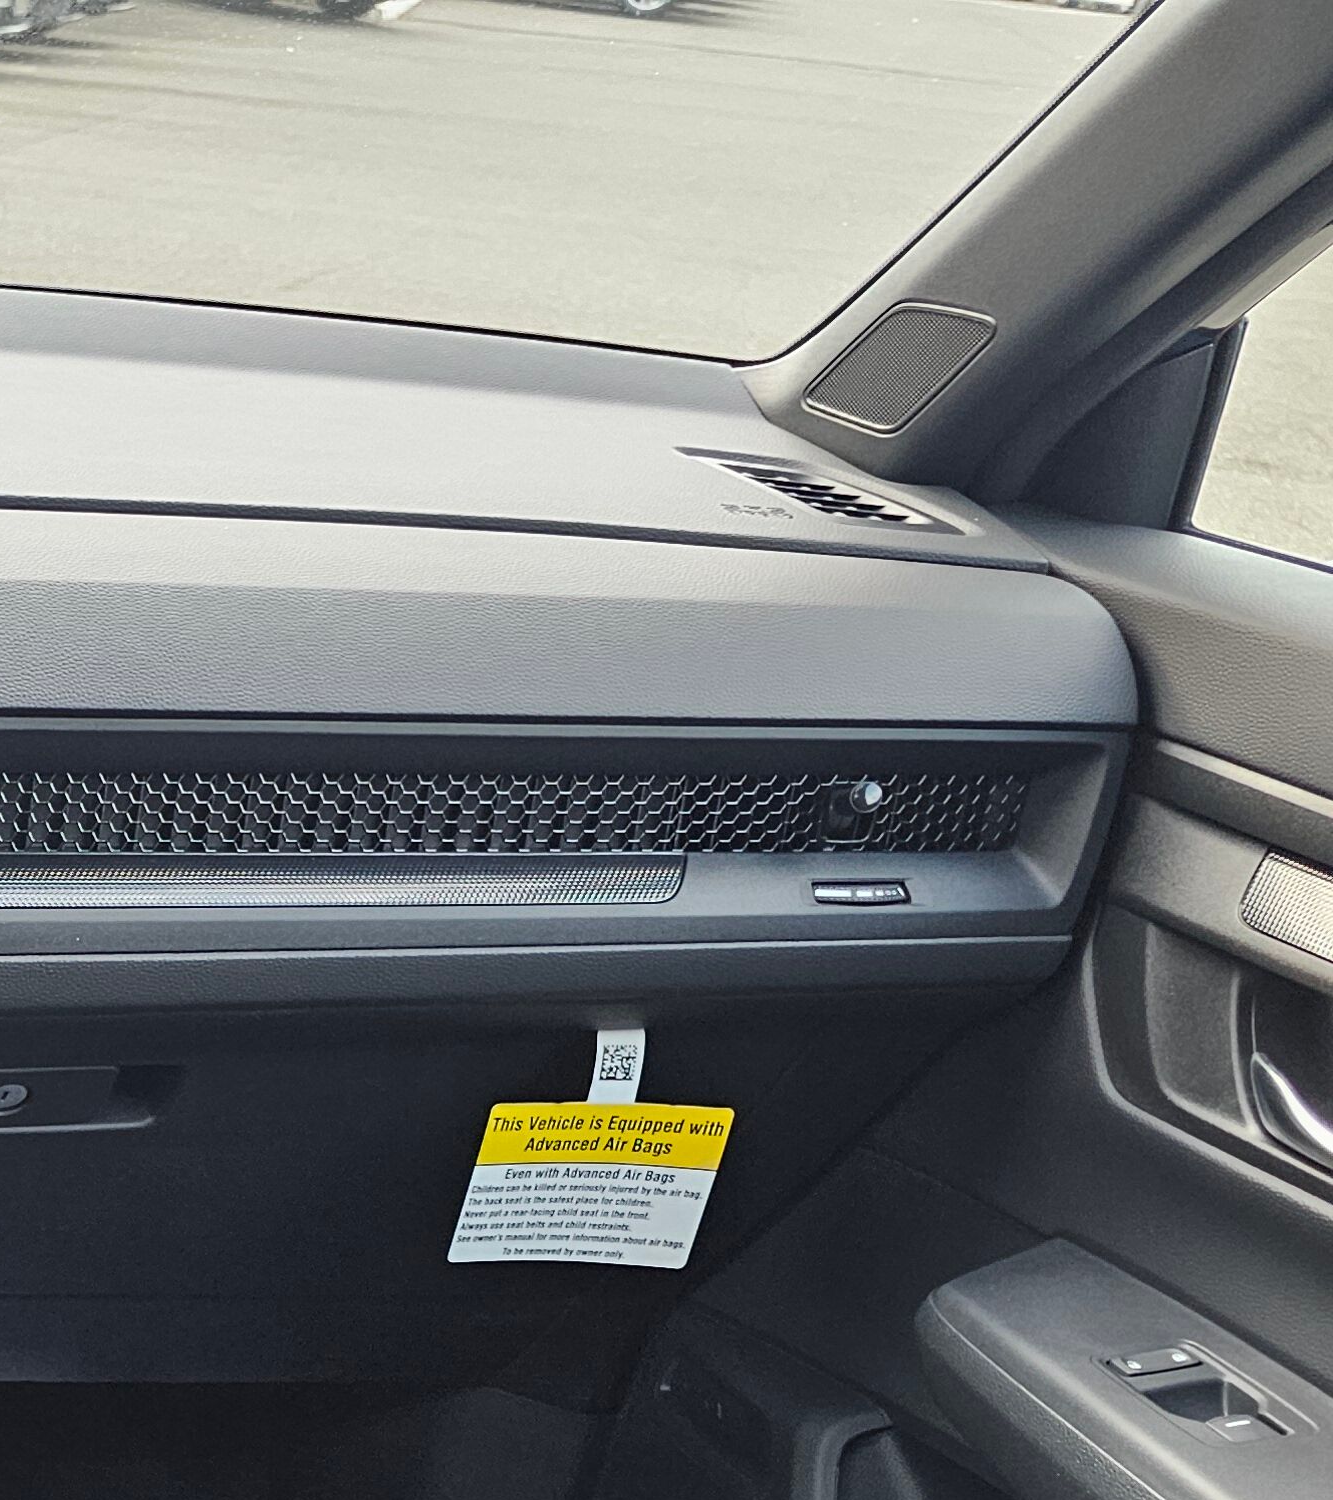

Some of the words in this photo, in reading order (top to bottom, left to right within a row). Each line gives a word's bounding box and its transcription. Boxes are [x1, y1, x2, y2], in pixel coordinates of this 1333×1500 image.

[492, 1117, 523, 1132] This
[529, 1115, 584, 1130] Vehicle
[589, 1115, 603, 1130] is
[608, 1115, 685, 1135] Equipped
[688, 1120, 725, 1137] with
[524, 1137, 598, 1152] Advanced
[602, 1137, 627, 1152] Air
[631, 1138, 673, 1156] Bags
[505, 1168, 532, 1179] Even
[535, 1167, 559, 1178] with
[562, 1167, 621, 1179] Advanced
[622, 1169, 642, 1181] Air
[644, 1171, 676, 1184] Bags
[471, 1185, 504, 1194] Children
[534, 1183, 556, 1191] killed
[569, 1183, 607, 1193] seriously
[608, 1185, 639, 1194] injured
[641, 1186, 652, 1196] by
[653, 1187, 668, 1196] the
[669, 1189, 682, 1198] air
[484, 1197, 503, 1205] back
[548, 1196, 574, 1204] safest
[575, 1196, 600, 1205] place
[601, 1196, 614, 1204] for
[488, 1209, 502, 1218] put
[557, 1208, 578, 1216] child
[580, 1209, 598, 1217] seat
[600, 1209, 609, 1217] in
[611, 1209, 625, 1218] the
[460, 1223, 487, 1231] Always
[506, 1221, 524, 1229] seat
[565, 1221, 586, 1229] child
[504, 1233, 535, 1241] manual
[536, 1233, 548, 1241] for
[572, 1233, 620, 1243] information
[622, 1236, 647, 1245] about
[648, 1238, 661, 1246] air
[502, 1247, 512, 1255] To
[514, 1247, 524, 1255] be
[525, 1247, 562, 1255] removed
[564, 1248, 574, 1257] by
[576, 1249, 602, 1257] owner
